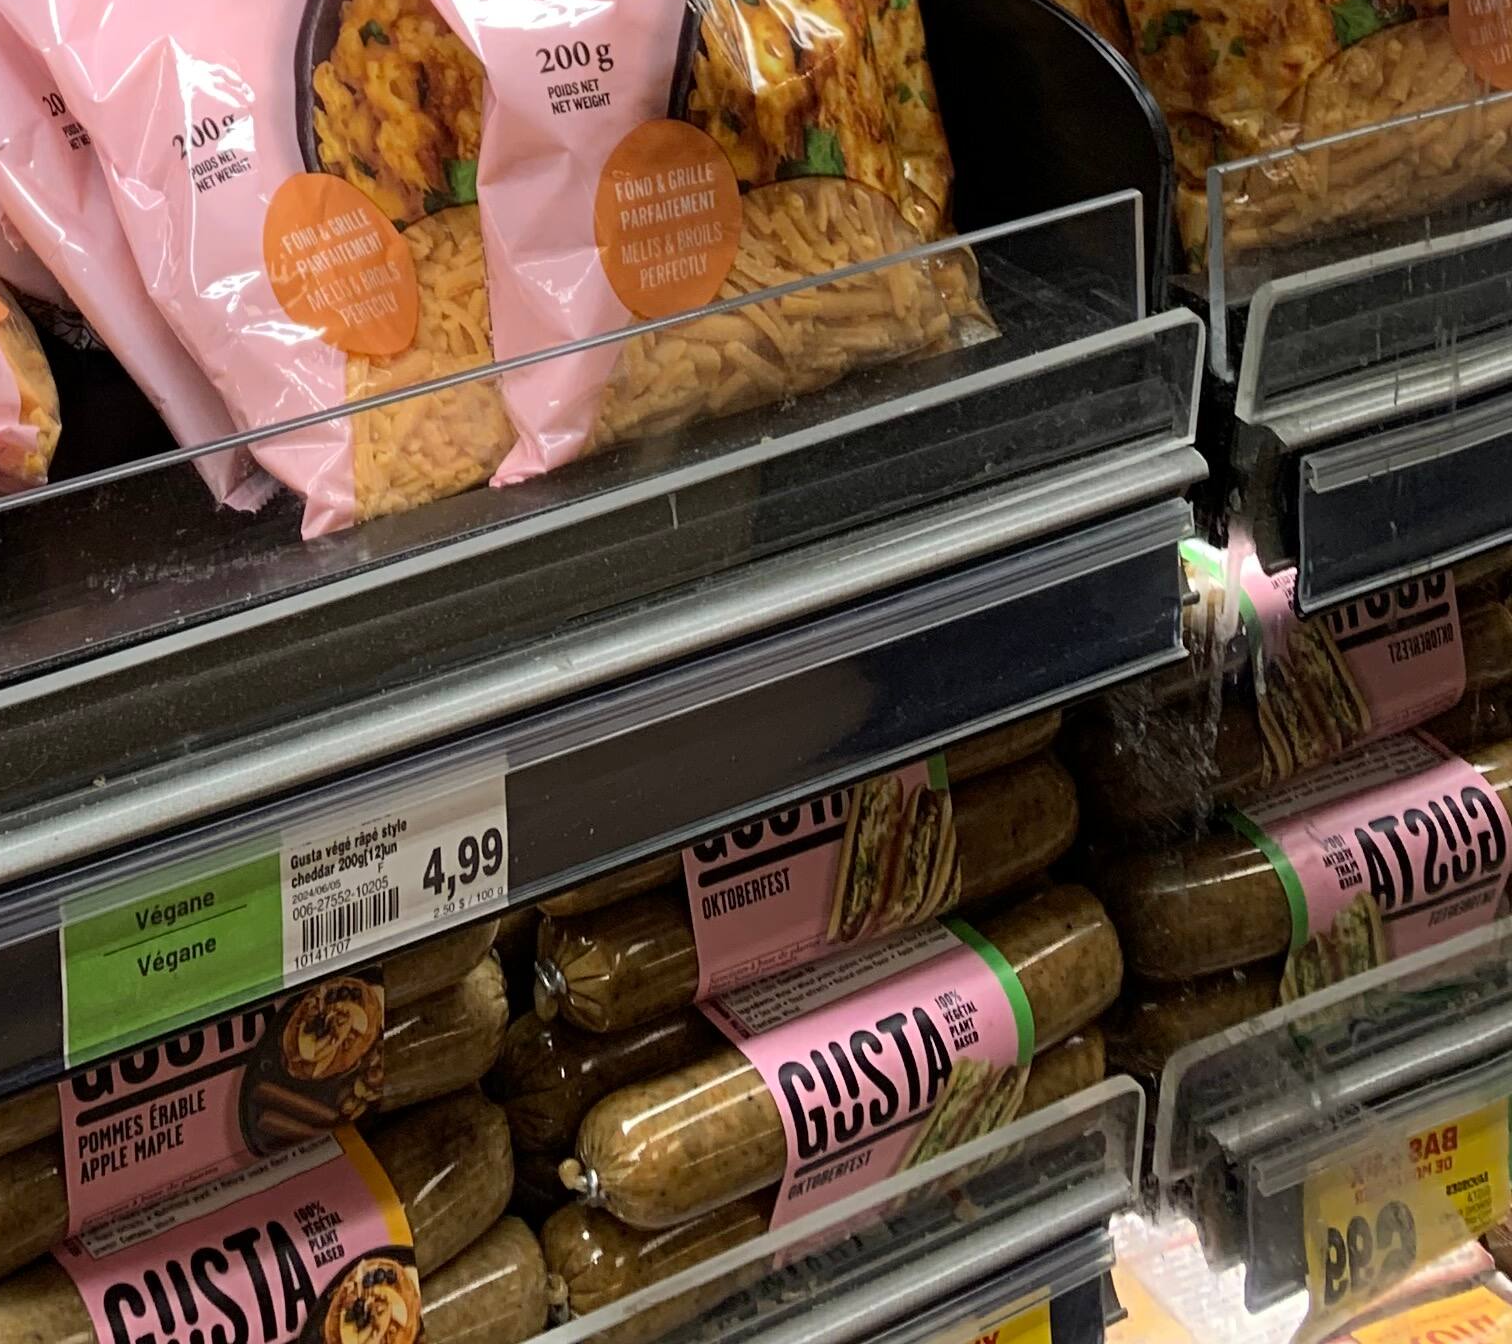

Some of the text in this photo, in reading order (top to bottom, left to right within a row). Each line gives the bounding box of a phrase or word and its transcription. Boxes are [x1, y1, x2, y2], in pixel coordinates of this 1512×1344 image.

[536, 41, 615, 74] 200 g
[620, 189, 716, 231] PARFAITEMENT
[422, 827, 504, 899] 4,99
[135, 889, 216, 933] Végane
[701, 867, 791, 921] OKTOBERFEST
[137, 935, 217, 978] Végane
[777, 1005, 953, 1161] GUSTA
[77, 1087, 208, 1159] POMMES ÉRABLE
[79, 1123, 184, 1186] APPLE MAPLE
